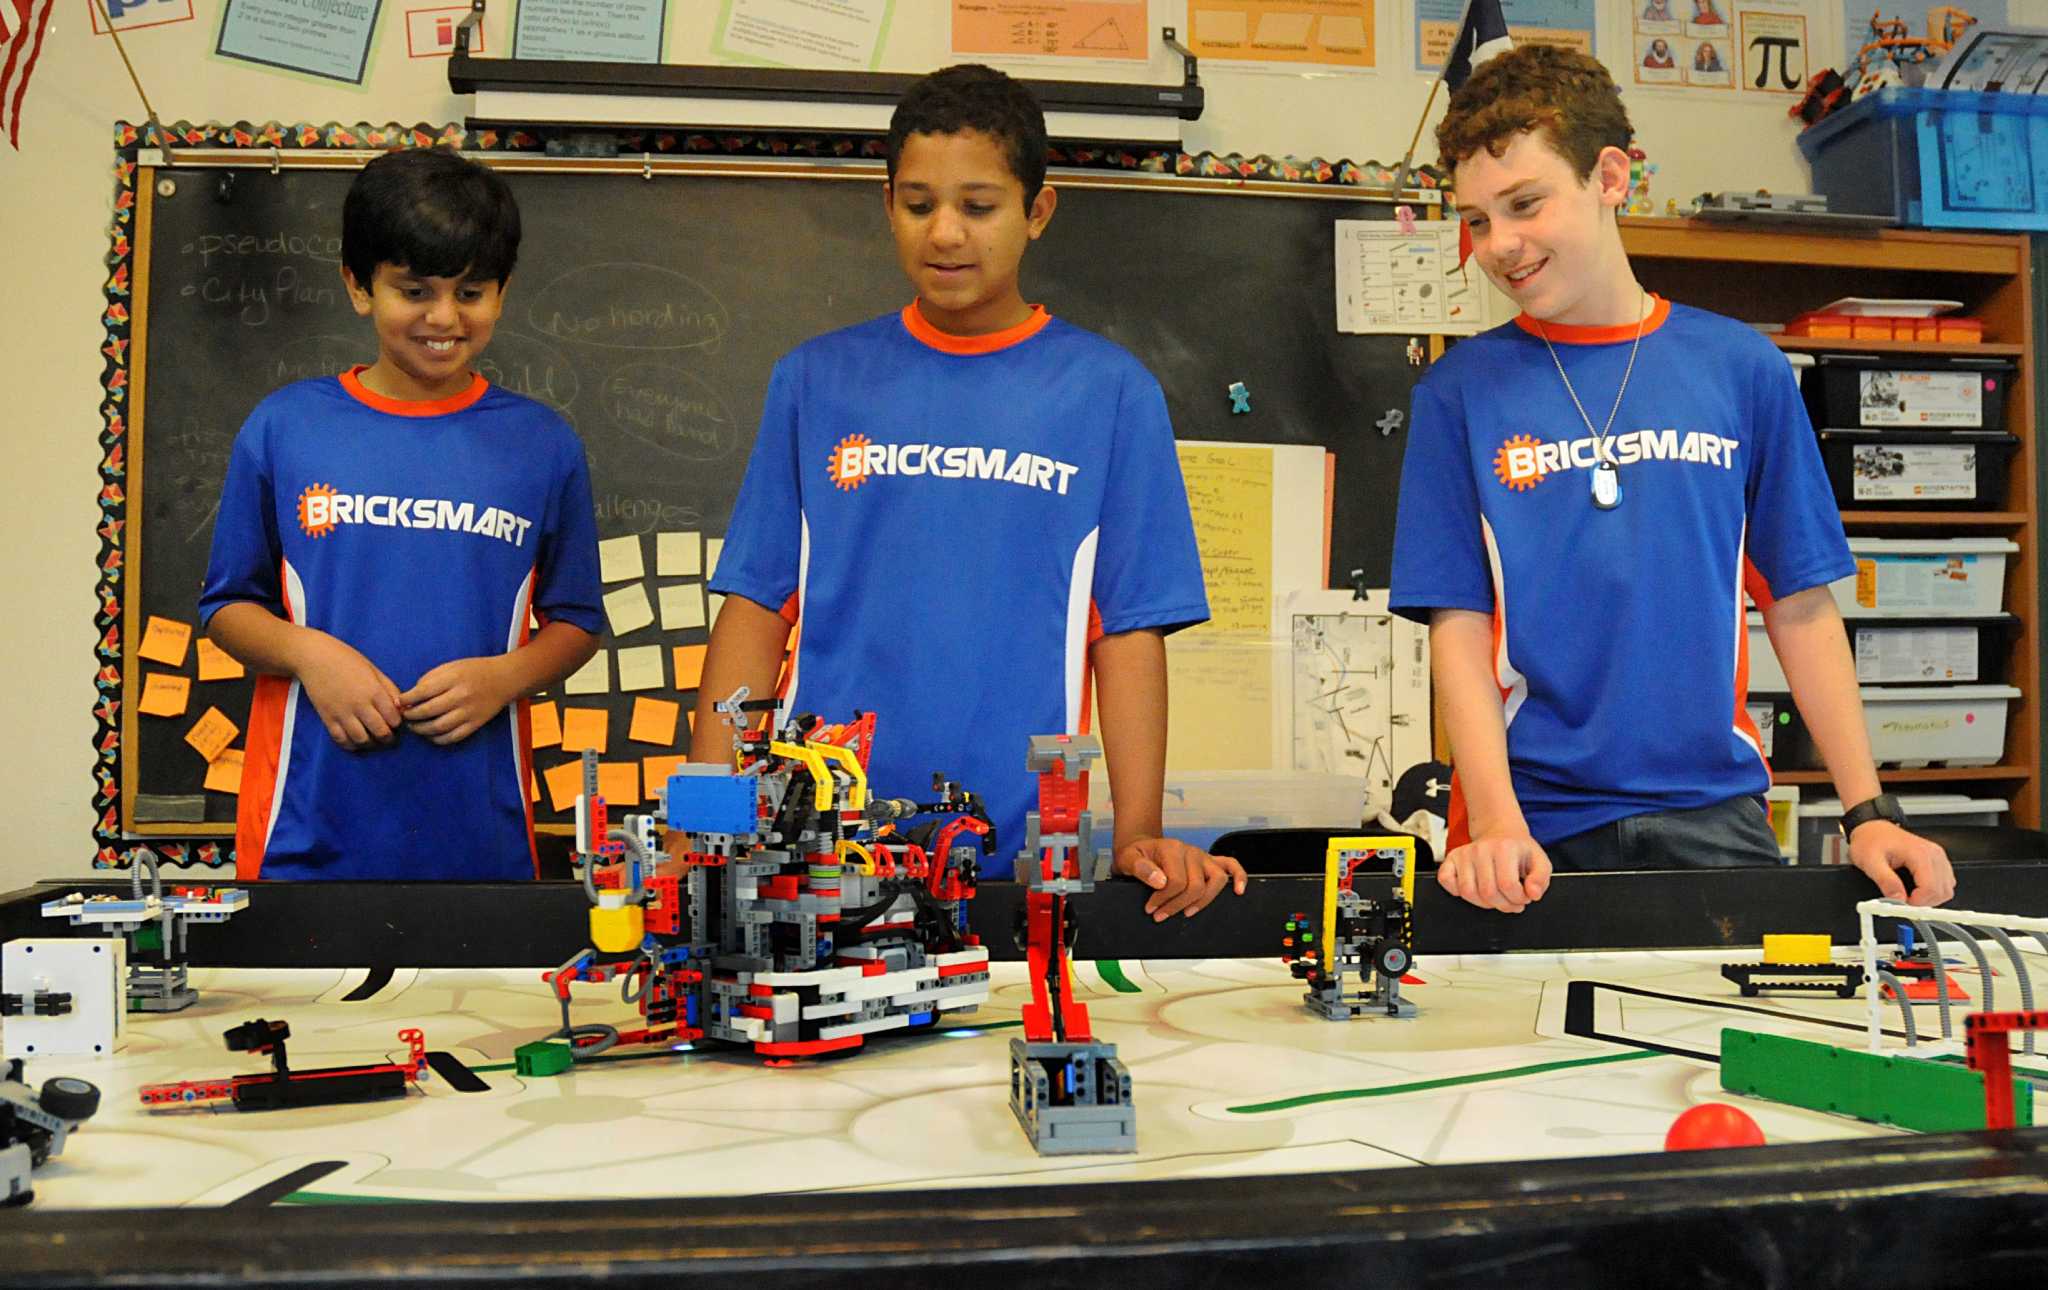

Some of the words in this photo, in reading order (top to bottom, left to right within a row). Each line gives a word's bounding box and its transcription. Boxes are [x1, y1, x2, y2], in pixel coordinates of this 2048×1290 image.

[202, 276, 269, 326] City
[841, 443, 1079, 495] BRICKSMART
[1508, 429, 1740, 480] BRICKSMART
[307, 494, 533, 547] BRICKSMART
[594, 494, 703, 535] allenges
